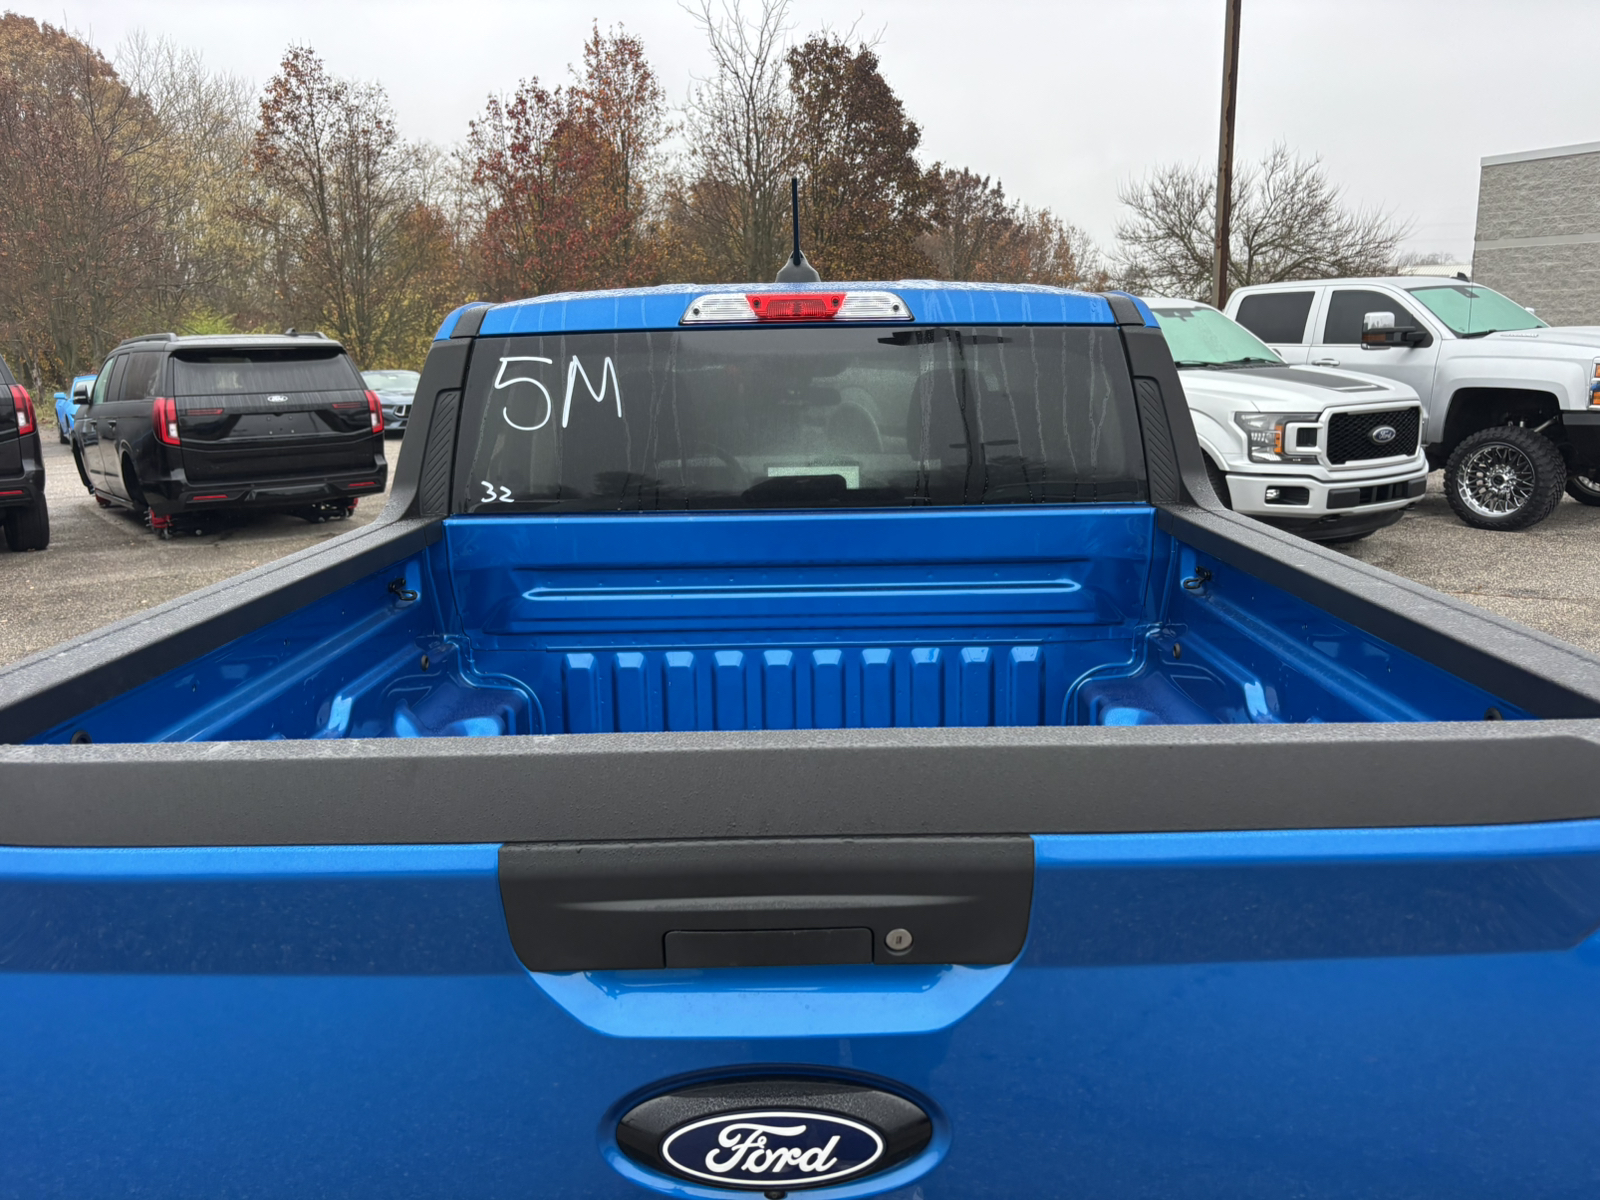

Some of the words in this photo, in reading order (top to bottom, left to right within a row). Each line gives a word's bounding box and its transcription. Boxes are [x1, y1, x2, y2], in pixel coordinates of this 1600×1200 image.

[493, 355, 622, 430] 5M
[480, 480, 515, 502] 32
[705, 1122, 841, 1173] Ford
